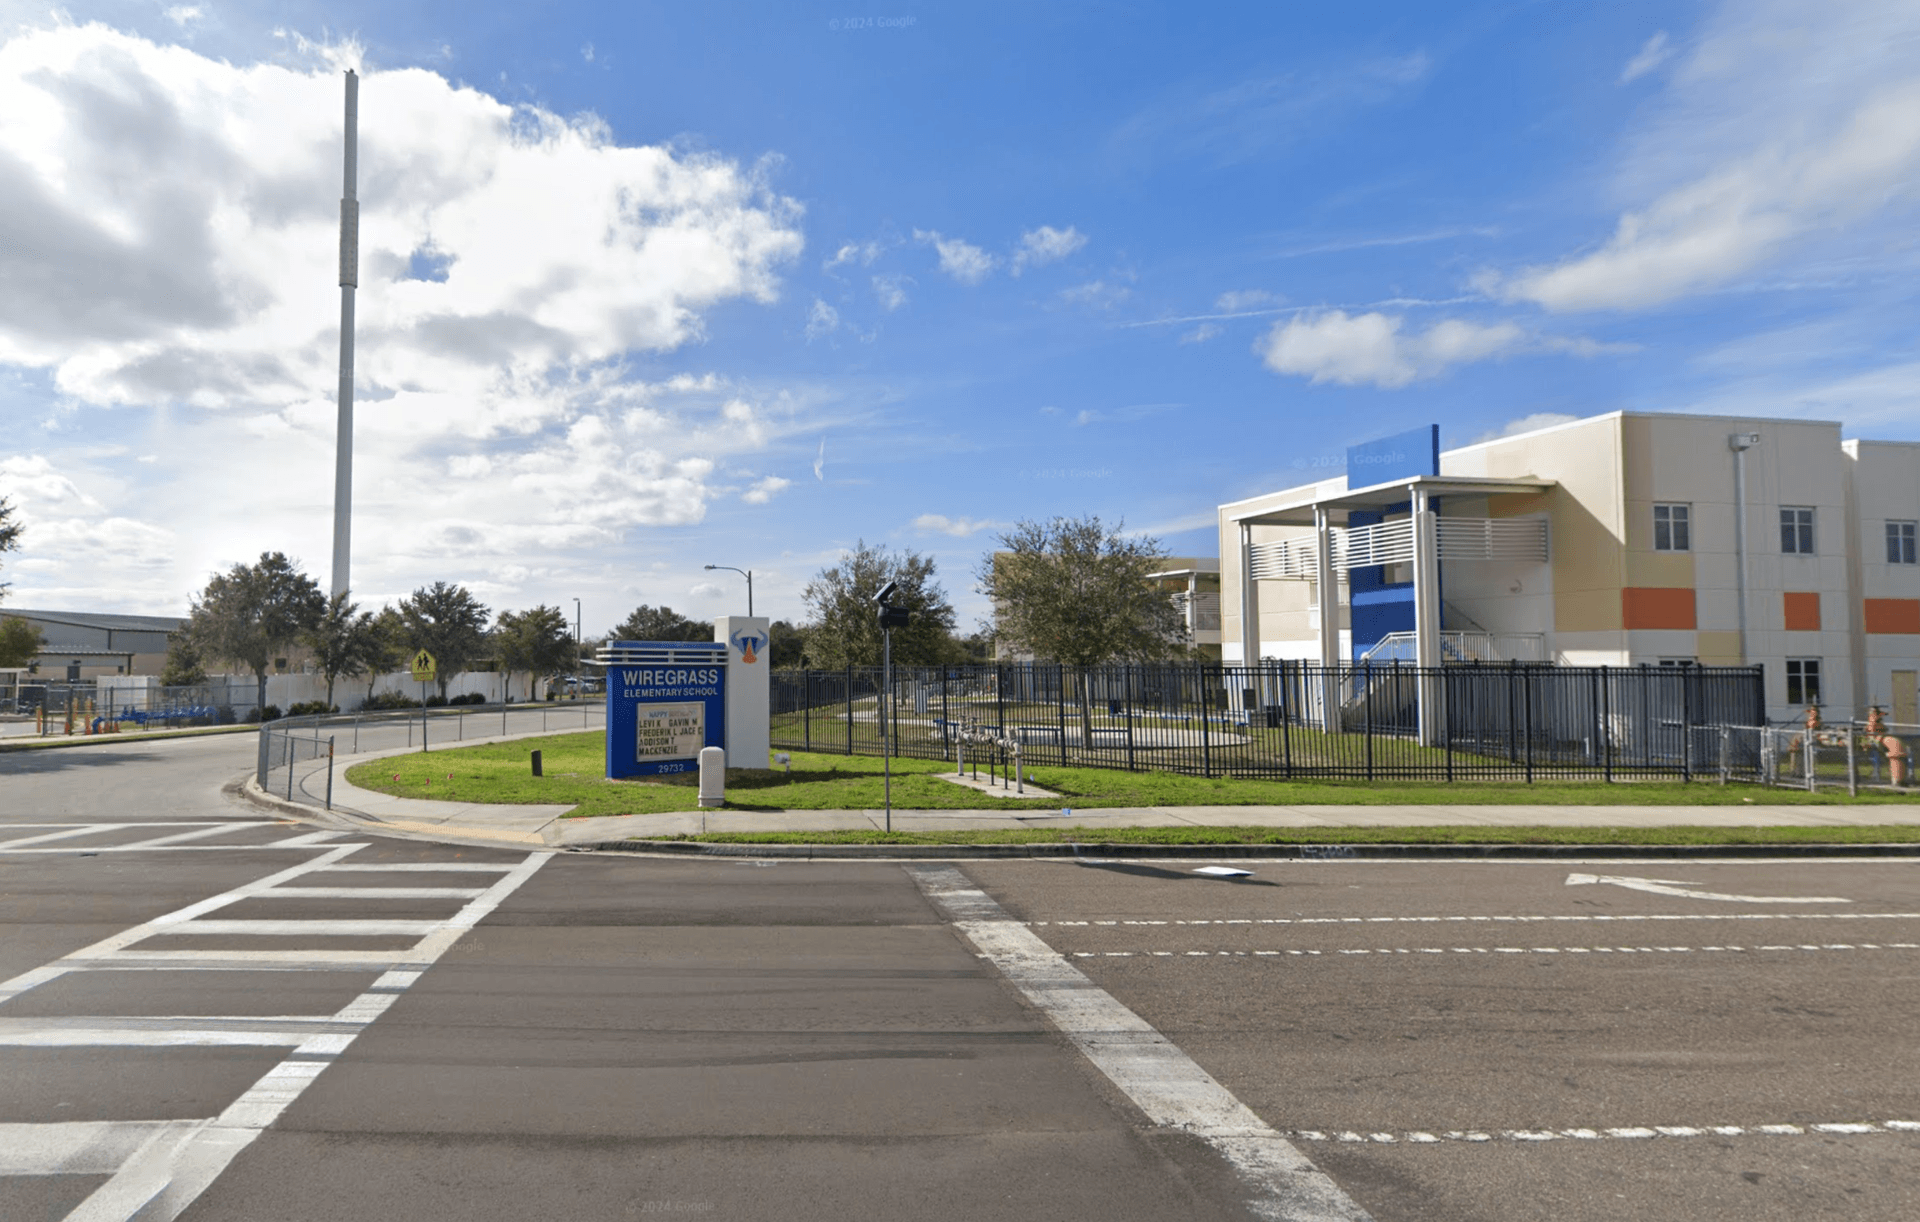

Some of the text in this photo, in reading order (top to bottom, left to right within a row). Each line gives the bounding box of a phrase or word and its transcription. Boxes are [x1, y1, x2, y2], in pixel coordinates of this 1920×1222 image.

[623, 669, 718, 686] WIREGRASS
[624, 687, 718, 697] ELEMENTARY SCHOOL
[639, 719, 662, 729] LEVI K
[668, 718, 690, 727] GAVIN
[639, 727, 672, 738] FREDERIK
[673, 727, 678, 736] L
[679, 726, 696, 736] JACE
[639, 736, 675, 746] ADDISON T
[639, 746, 678, 755] MACKENZIE
[658, 764, 685, 773] 29732
